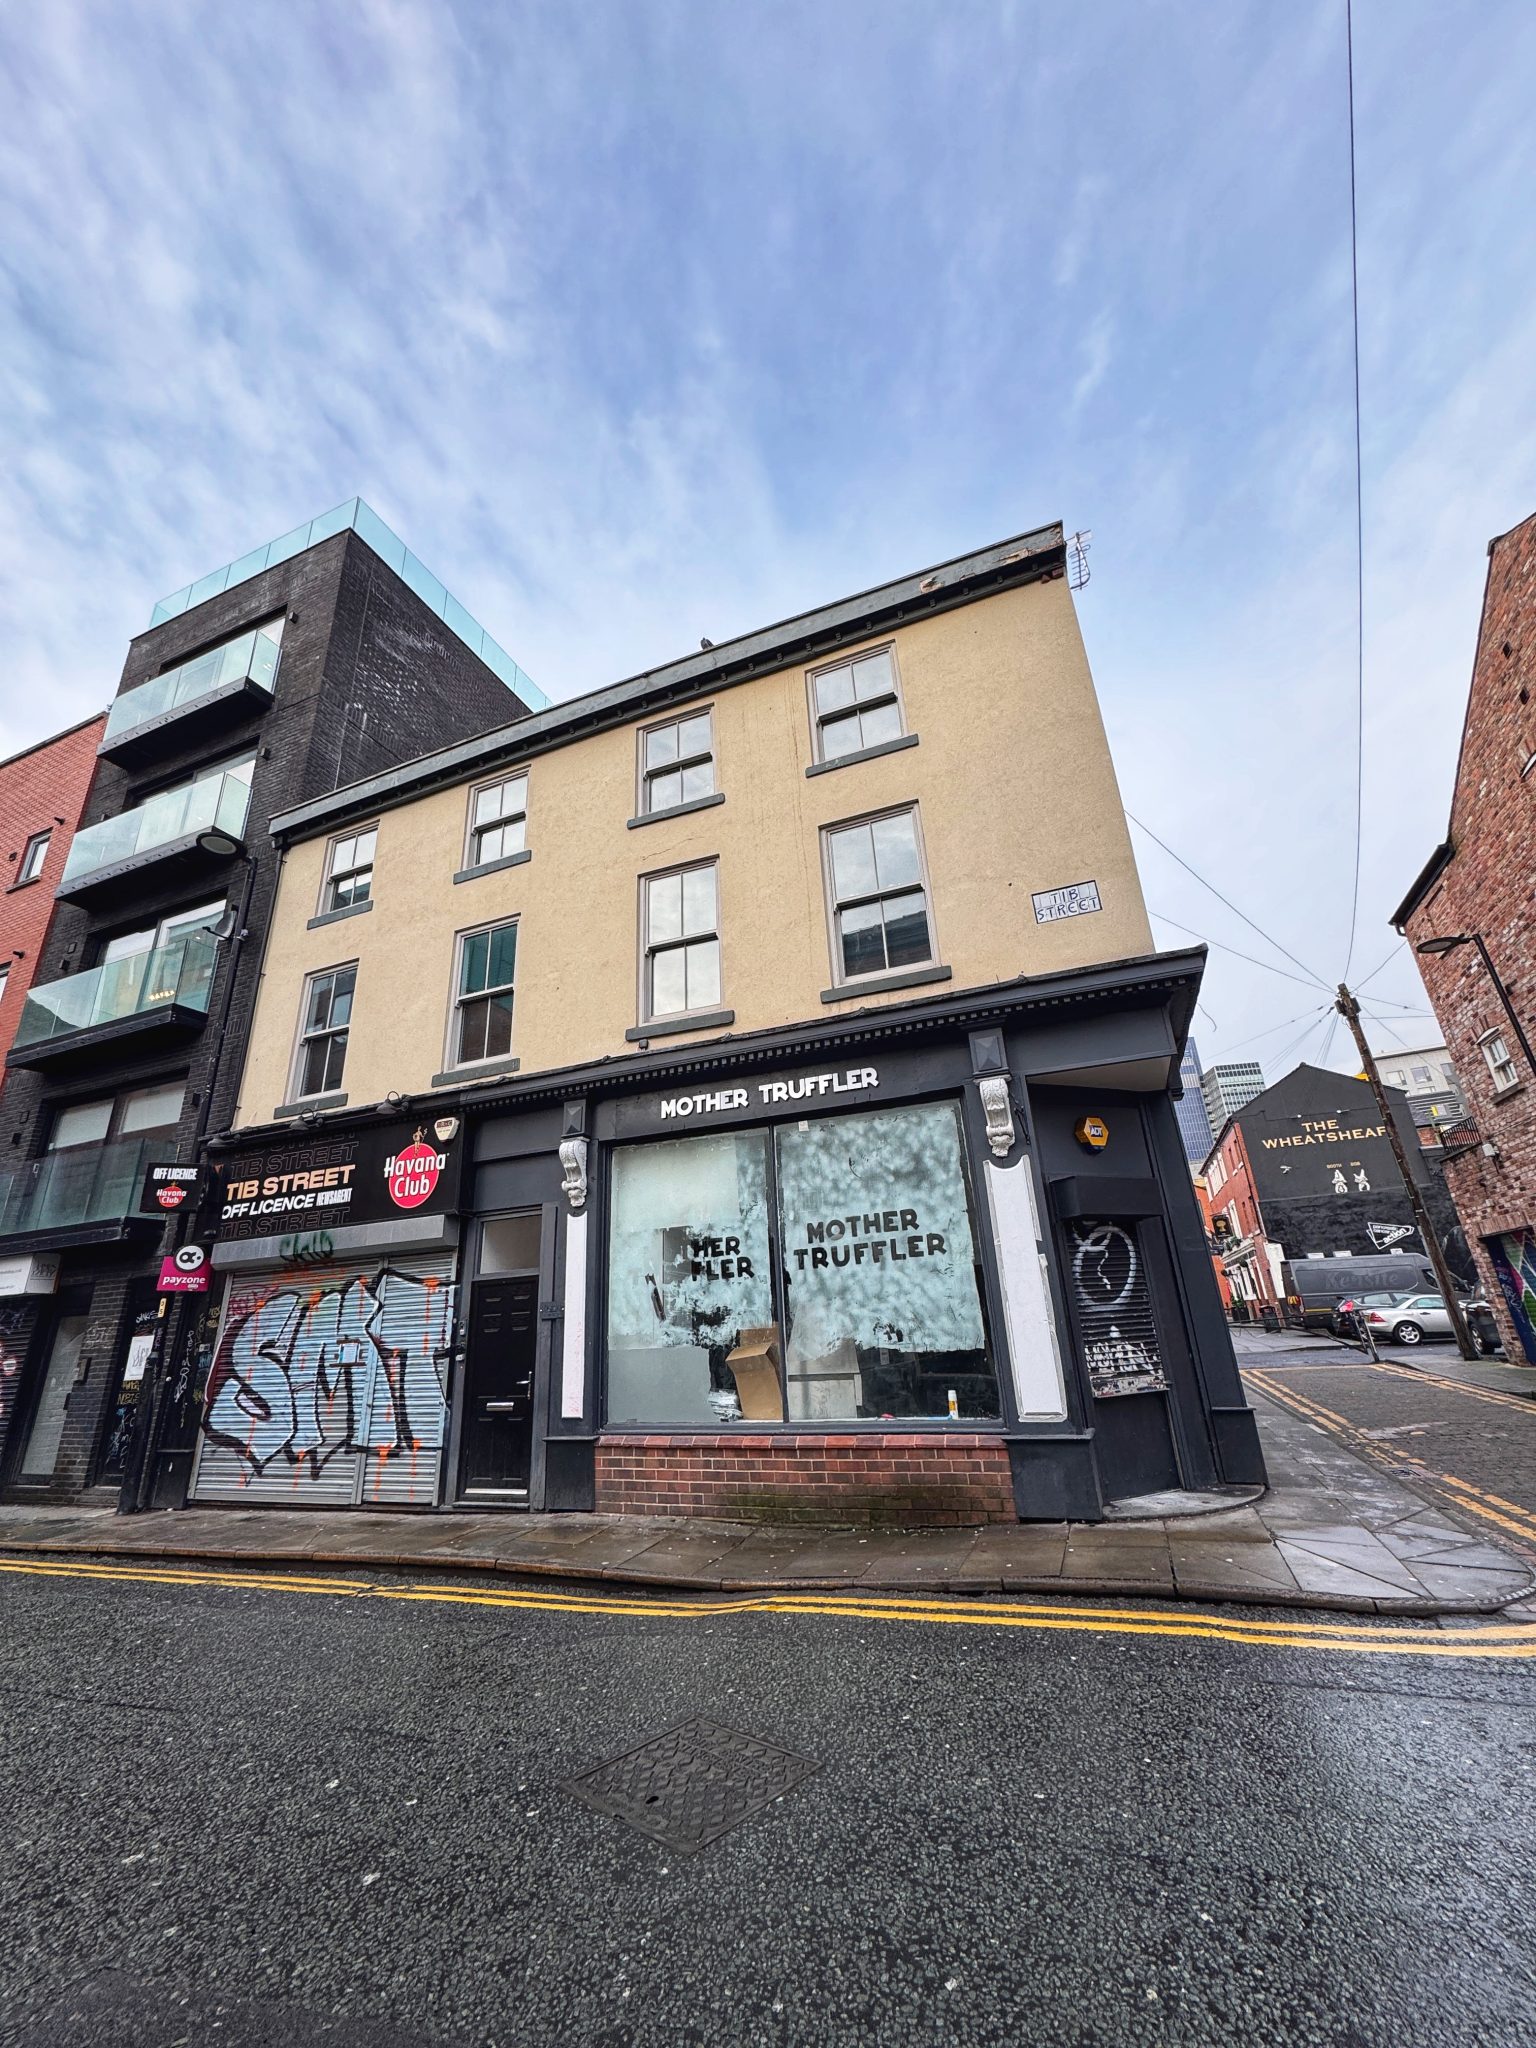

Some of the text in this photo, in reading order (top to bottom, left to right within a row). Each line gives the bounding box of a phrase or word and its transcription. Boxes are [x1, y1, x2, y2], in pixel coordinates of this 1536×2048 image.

[1050, 888, 1078, 904] TIB
[1038, 897, 1097, 920] STREET
[660, 1068, 879, 1119] MOTHER TRUFFLER
[1262, 1126, 1386, 1149] WHEATSHEAF
[1302, 1120, 1339, 1132] THE
[231, 1157, 263, 1180] TIB
[266, 1141, 360, 1174] STREET
[384, 1153, 446, 1178] Havana
[153, 1168, 198, 1180] OFF LICENCE
[226, 1164, 356, 1201] TIB STREET
[156, 1188, 187, 1197] Havana
[394, 1174, 430, 1198] Club
[161, 1196, 180, 1204] Club
[222, 1202, 250, 1220] OFF
[250, 1193, 316, 1216] LICENCE
[220, 1207, 350, 1239] TIB STREET
[806, 1208, 919, 1244] MOTHER
[1382, 1228, 1407, 1244] action
[793, 1233, 947, 1270] TRUFFLER
[162, 1276, 206, 1286] payzone
